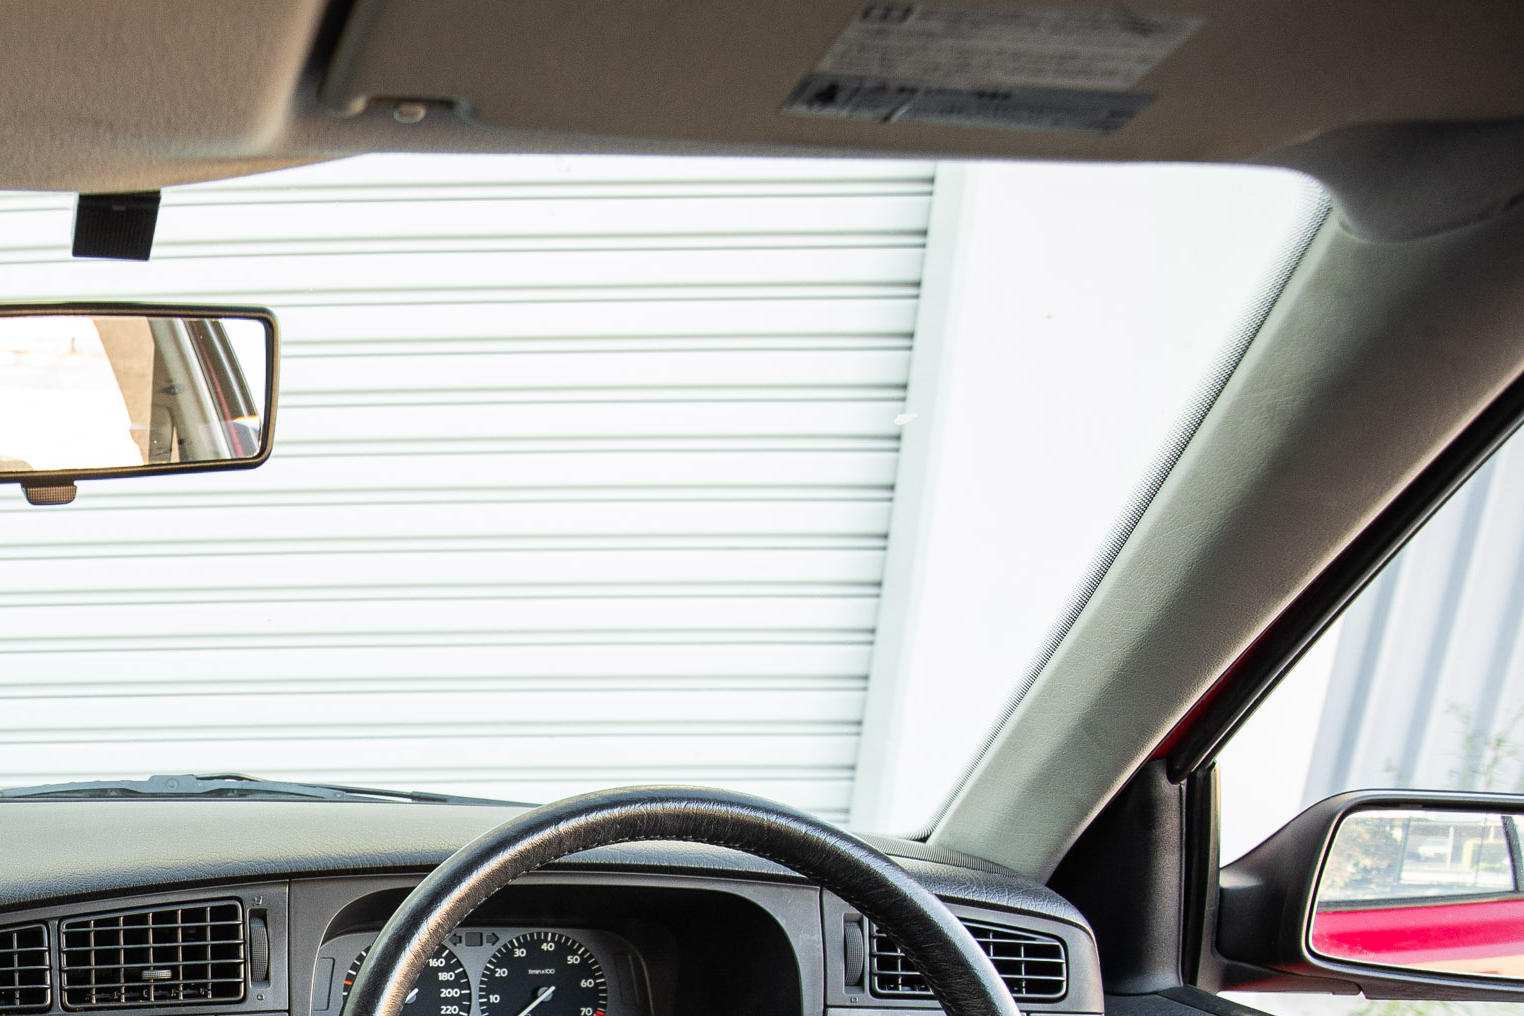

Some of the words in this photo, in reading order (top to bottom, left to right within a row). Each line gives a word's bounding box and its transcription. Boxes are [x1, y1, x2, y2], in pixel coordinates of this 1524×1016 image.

[541, 942, 555, 951] 40
[513, 948, 527, 957] 30
[428, 958, 446, 967] 160
[567, 955, 580, 964] 50
[437, 972, 455, 981] 180
[494, 968, 508, 977] 20
[580, 979, 594, 988] 60
[440, 988, 460, 998] 200
[489, 994, 500, 1003] 10
[440, 1005, 459, 1015] 220
[580, 1007, 593, 1016] 70
